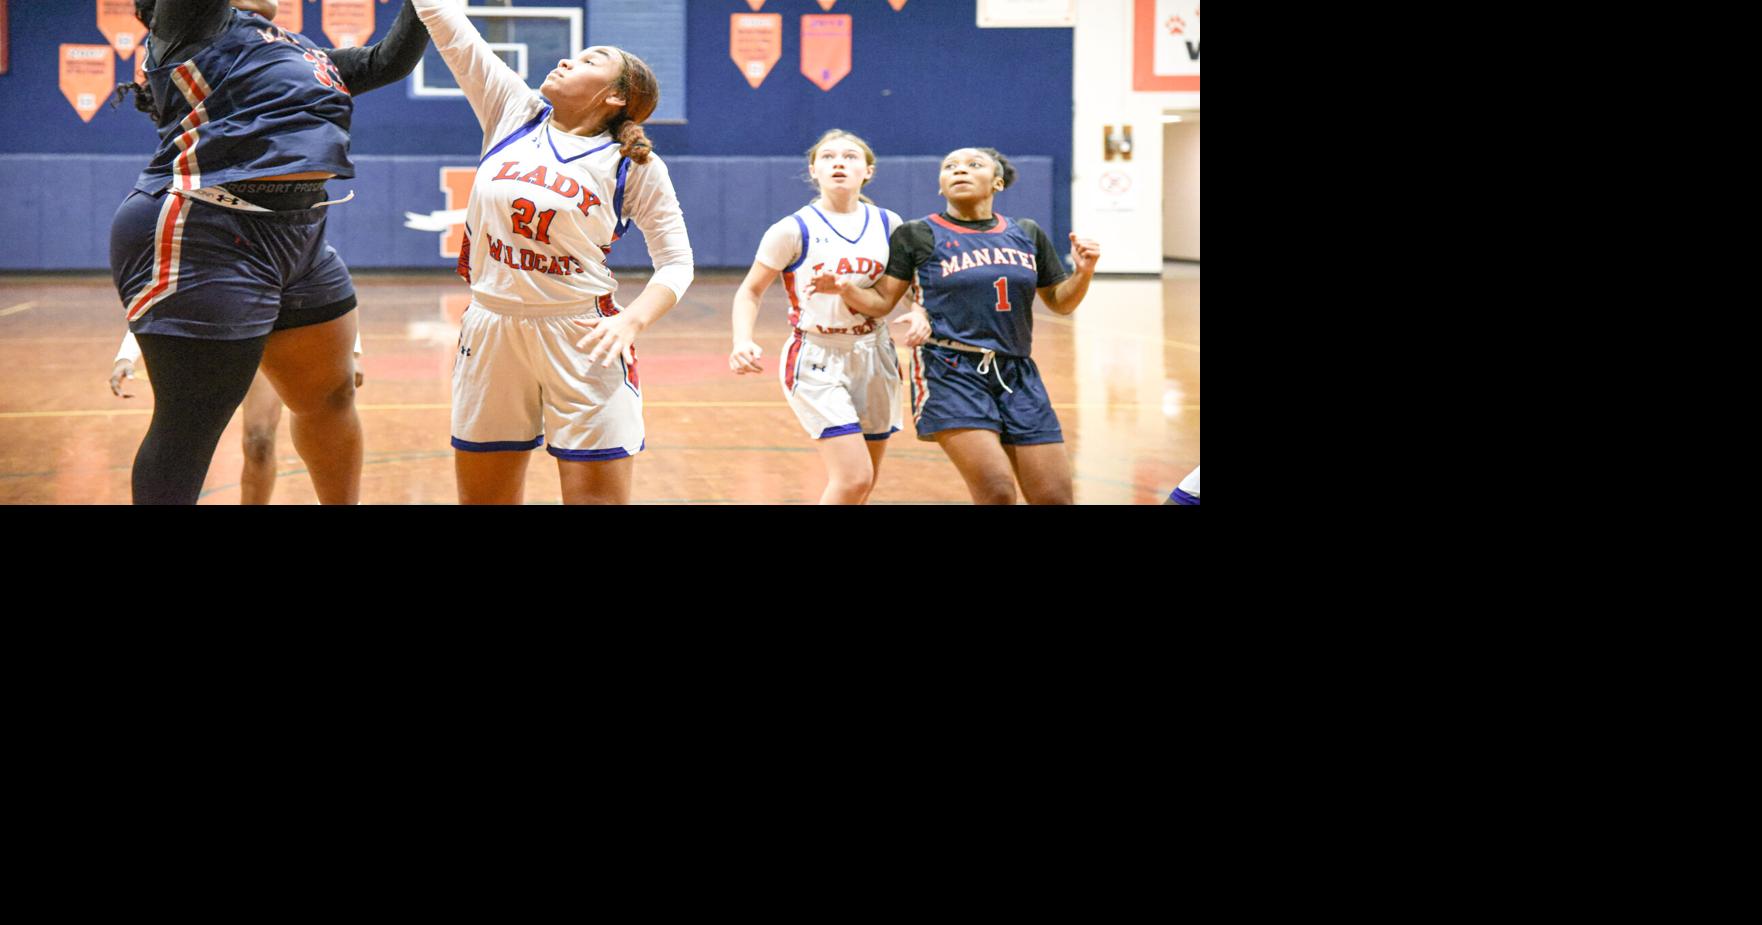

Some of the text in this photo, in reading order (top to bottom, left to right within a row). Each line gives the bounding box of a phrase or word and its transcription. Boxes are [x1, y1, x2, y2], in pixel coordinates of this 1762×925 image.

[224, 183, 292, 193] ROSPORT
[491, 161, 602, 217] LADY
[511, 197, 557, 244] 21
[486, 233, 584, 275] WLDCATS
[993, 276, 1012, 312] 1
